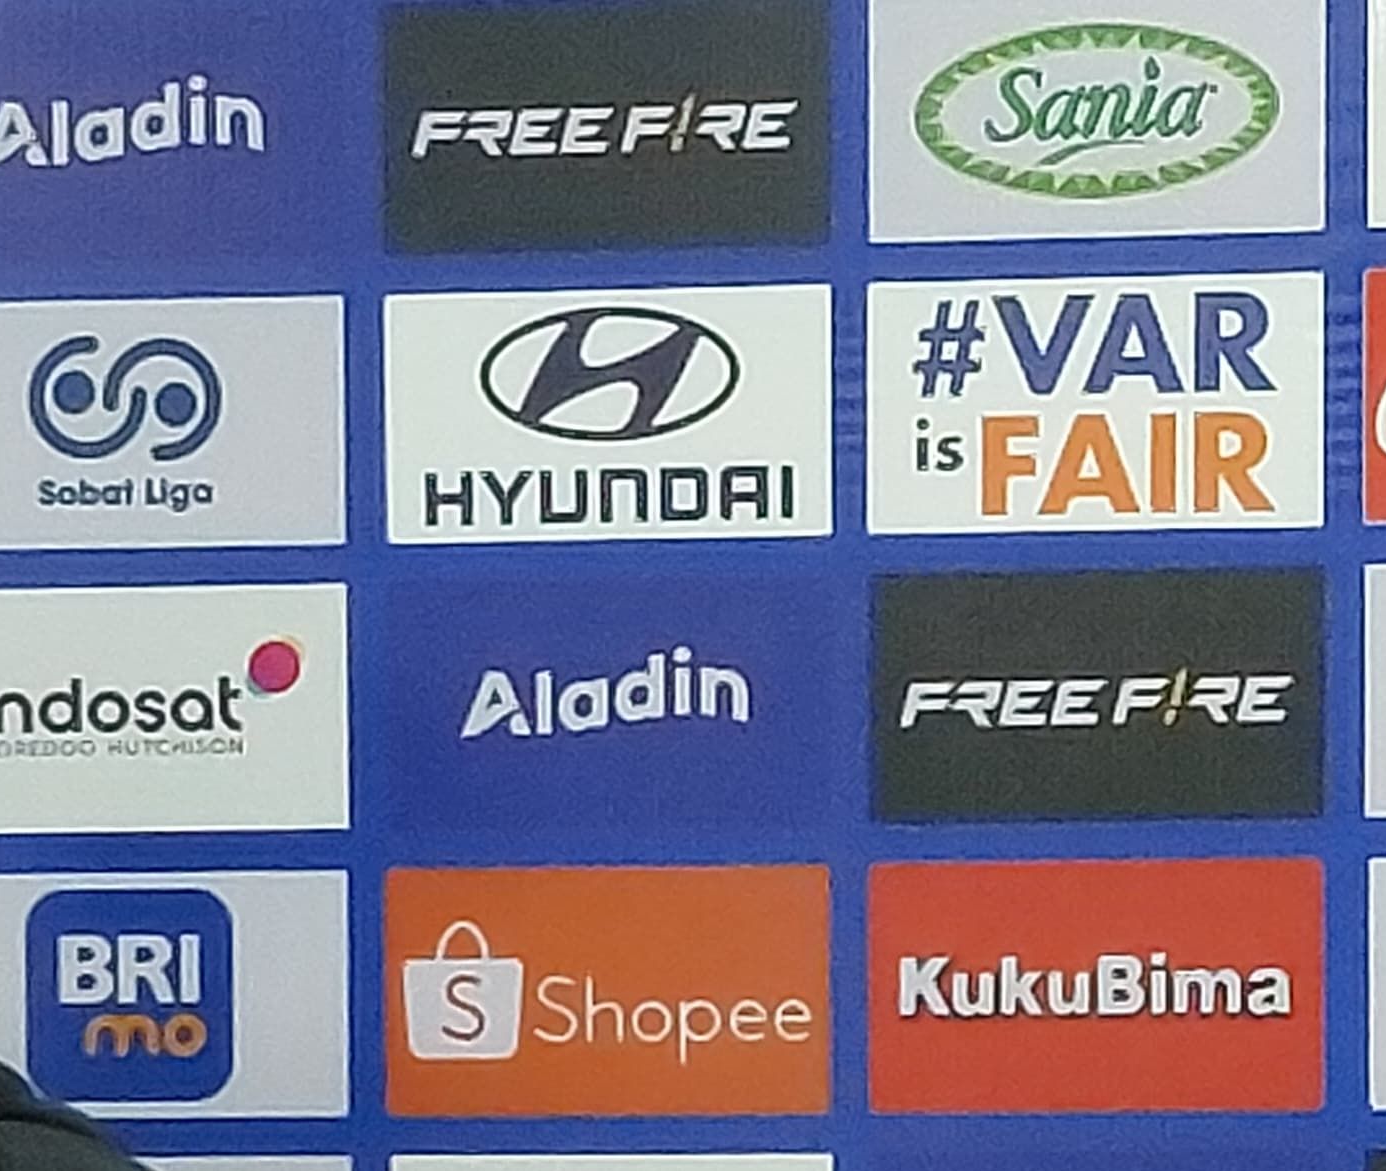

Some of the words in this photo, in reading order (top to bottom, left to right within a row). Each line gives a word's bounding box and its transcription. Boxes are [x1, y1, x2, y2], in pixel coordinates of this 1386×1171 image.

[414, 107, 616, 159] FREE
[984, 56, 1207, 145] Sania
[913, 292, 1278, 397] #VAR
[38, 478, 133, 506] Sobat
[145, 477, 212, 512] Liga
[425, 466, 794, 526] HYUNDAI
[916, 419, 964, 471] is
[981, 411, 1275, 516] FAIR
[460, 646, 750, 739] Aladin
[899, 679, 1108, 727] FREE
[57, 934, 201, 1005] BRI
[899, 952, 1291, 1017] KukuBima
[83, 1013, 209, 1058] mo
[533, 970, 812, 1063] Shopee
